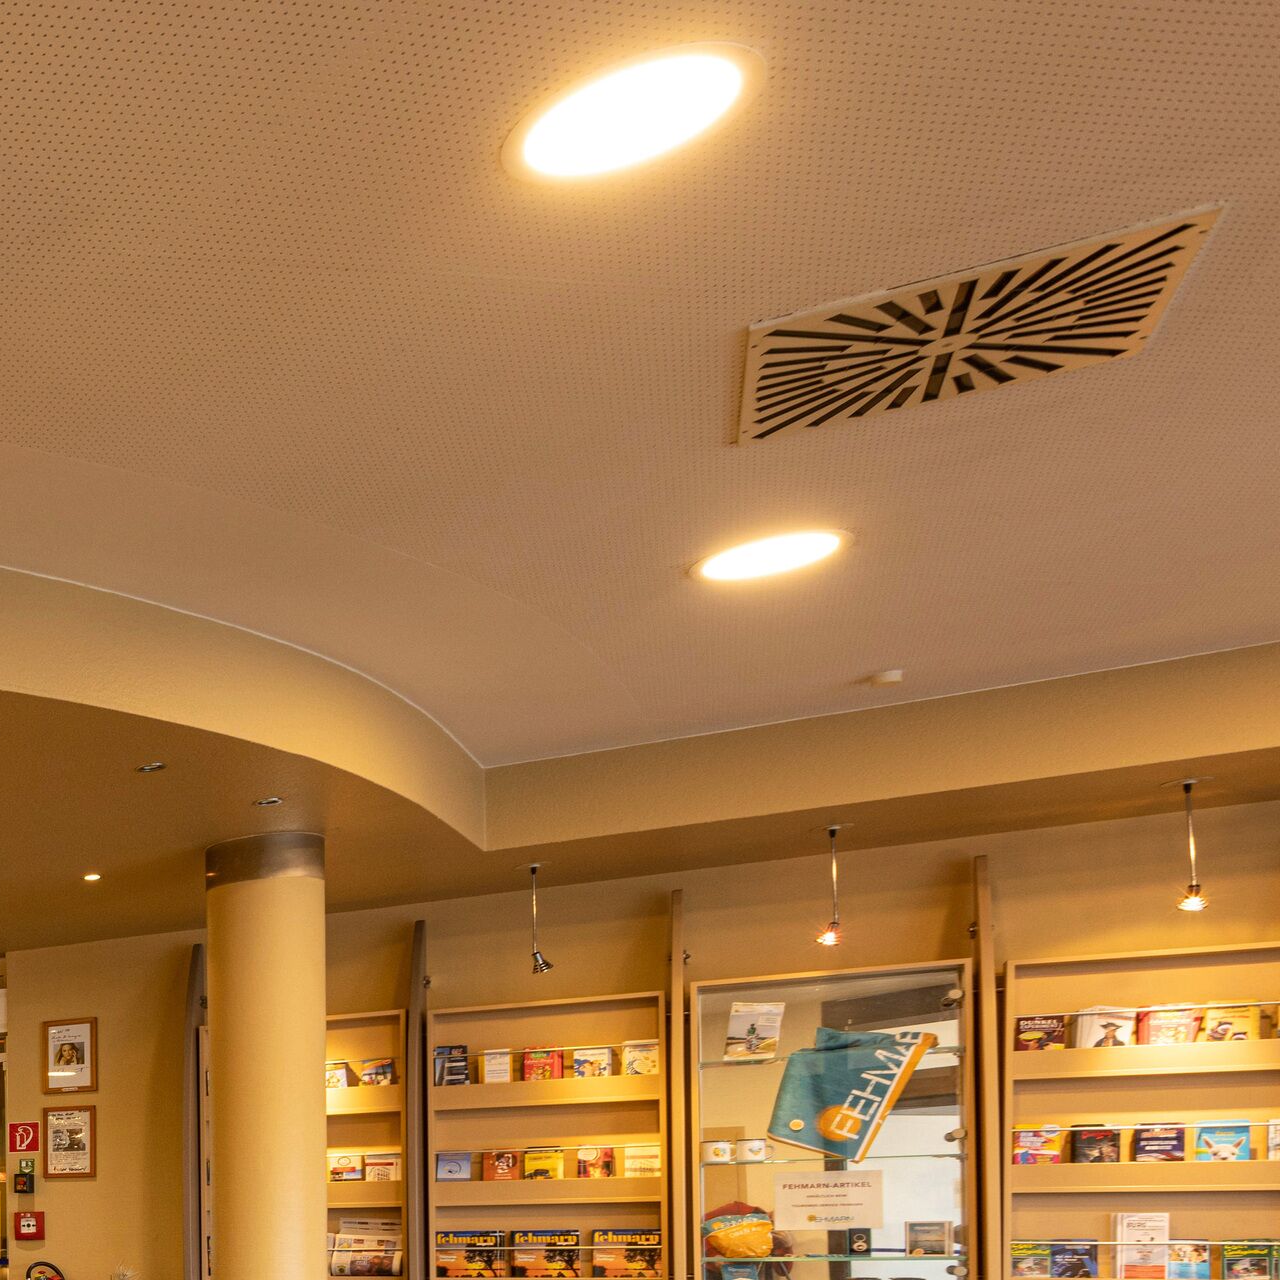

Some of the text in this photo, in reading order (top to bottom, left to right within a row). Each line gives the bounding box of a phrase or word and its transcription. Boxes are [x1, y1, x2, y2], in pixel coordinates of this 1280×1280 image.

[782, 1181, 872, 1190] FEHMARN-ARTIKEL
[436, 1233, 497, 1245] fehmarn
[515, 1231, 578, 1244] fehmarn
[593, 1230, 660, 1243] fehmarn
